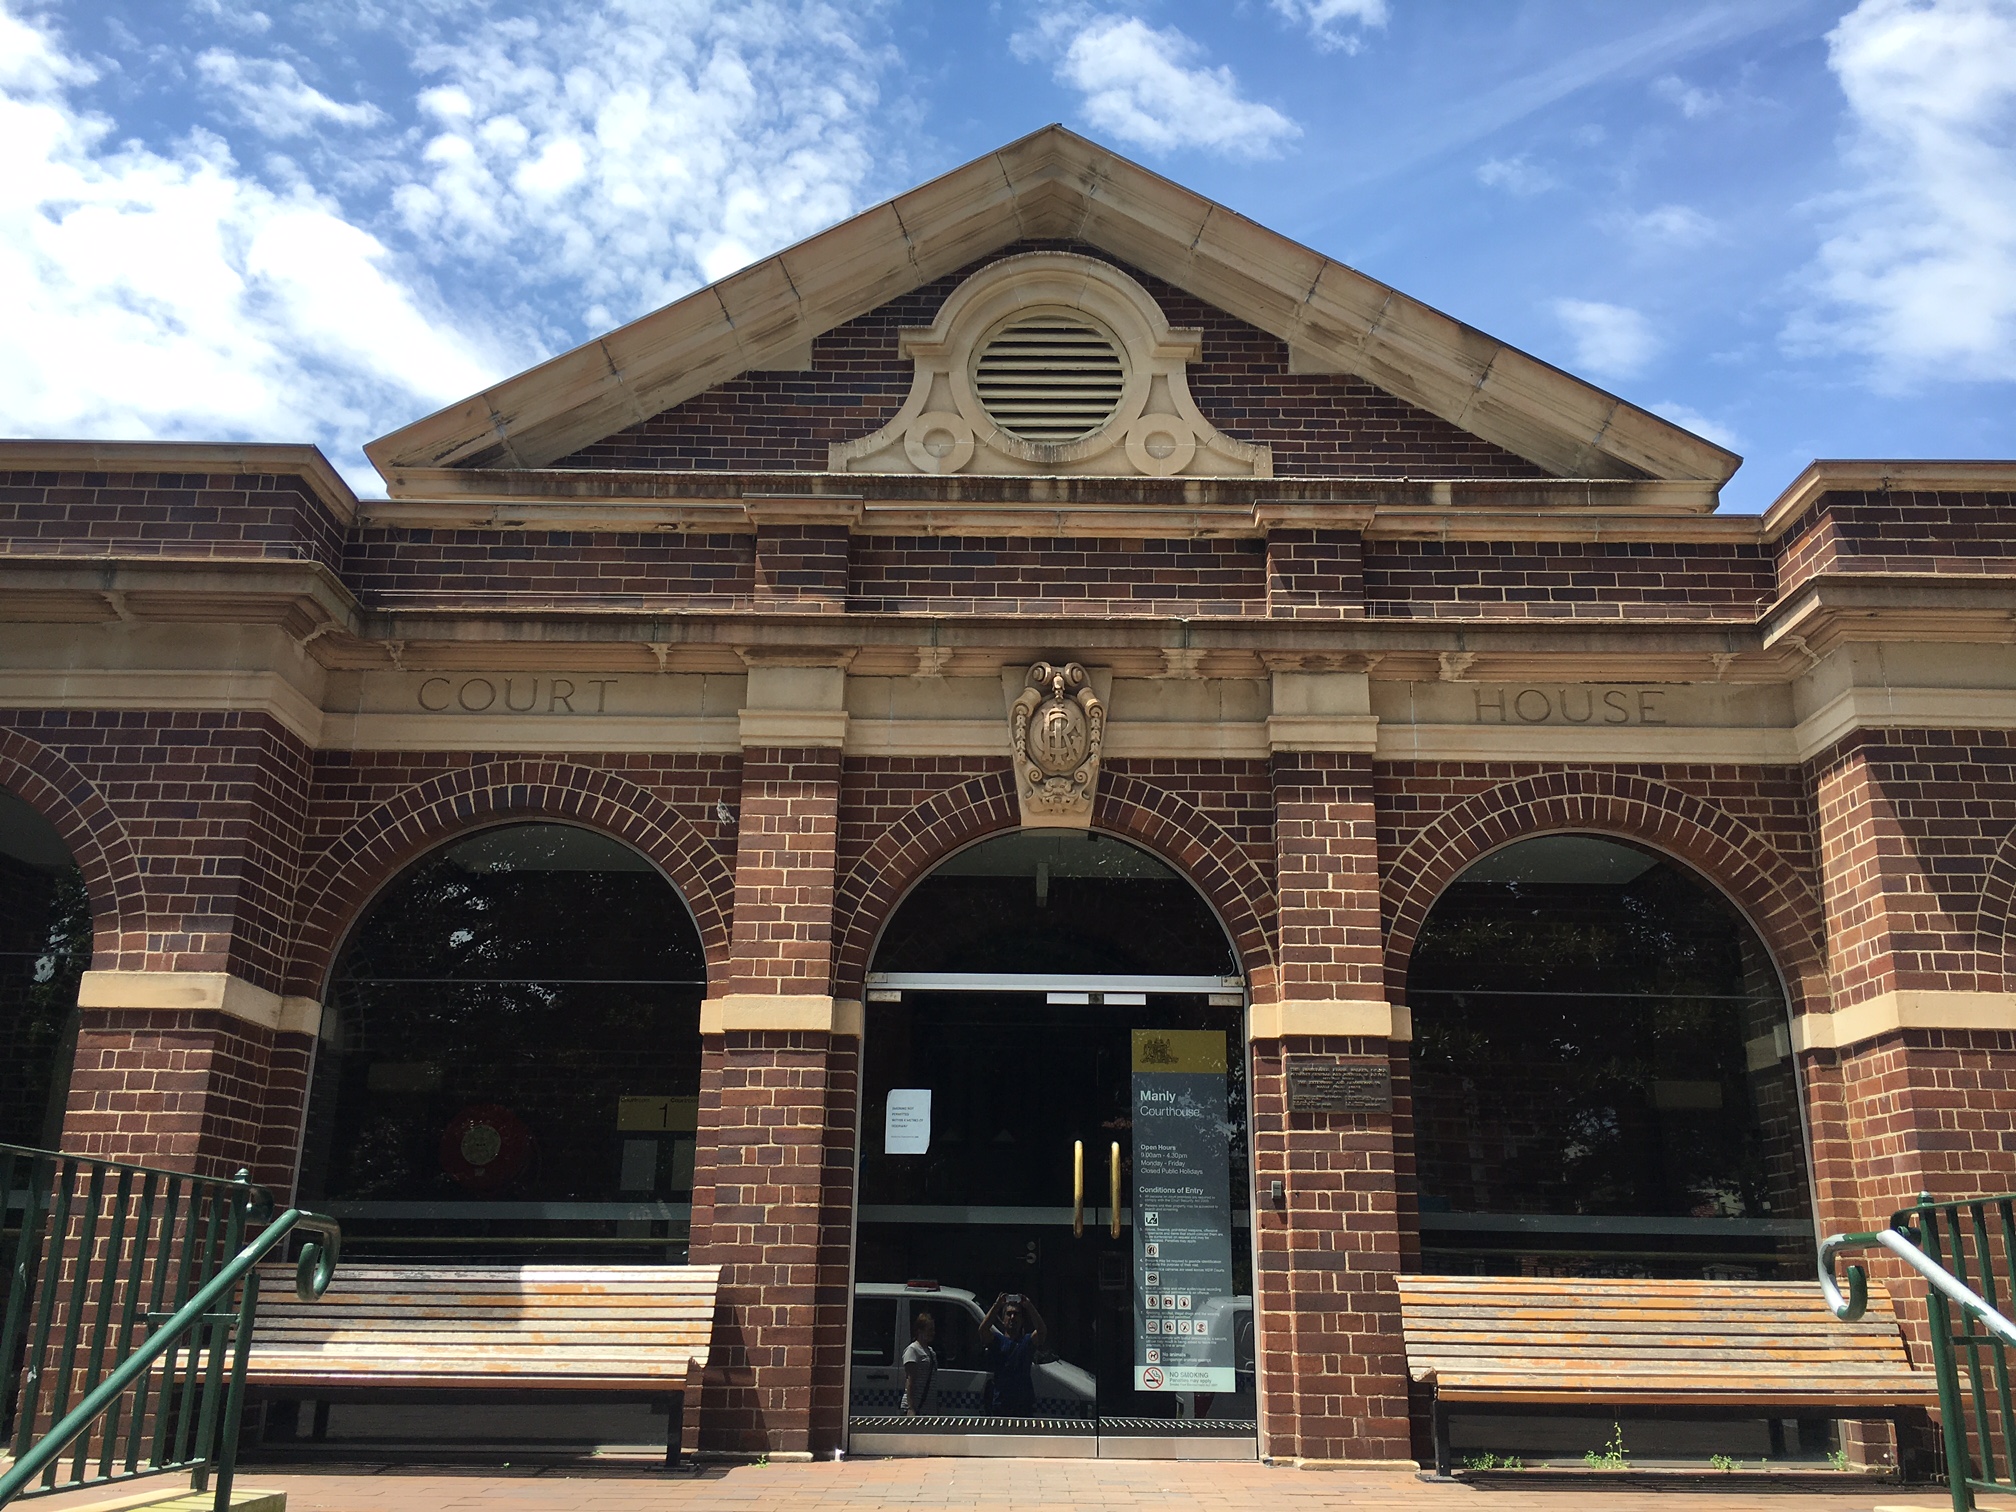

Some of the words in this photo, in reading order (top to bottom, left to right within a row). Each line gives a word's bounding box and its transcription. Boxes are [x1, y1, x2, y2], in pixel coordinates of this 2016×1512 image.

[417, 677, 619, 713] COURT
[1473, 687, 1667, 724] HOUSE
[1140, 1090, 1176, 1103] Manly
[658, 1103, 668, 1128] 1
[1140, 1105, 1200, 1117] Courthouse
[1168, 1160, 1186, 1168] Friday
[1139, 1186, 1176, 1194] Conditions
[1185, 1187, 1204, 1195] Entry
